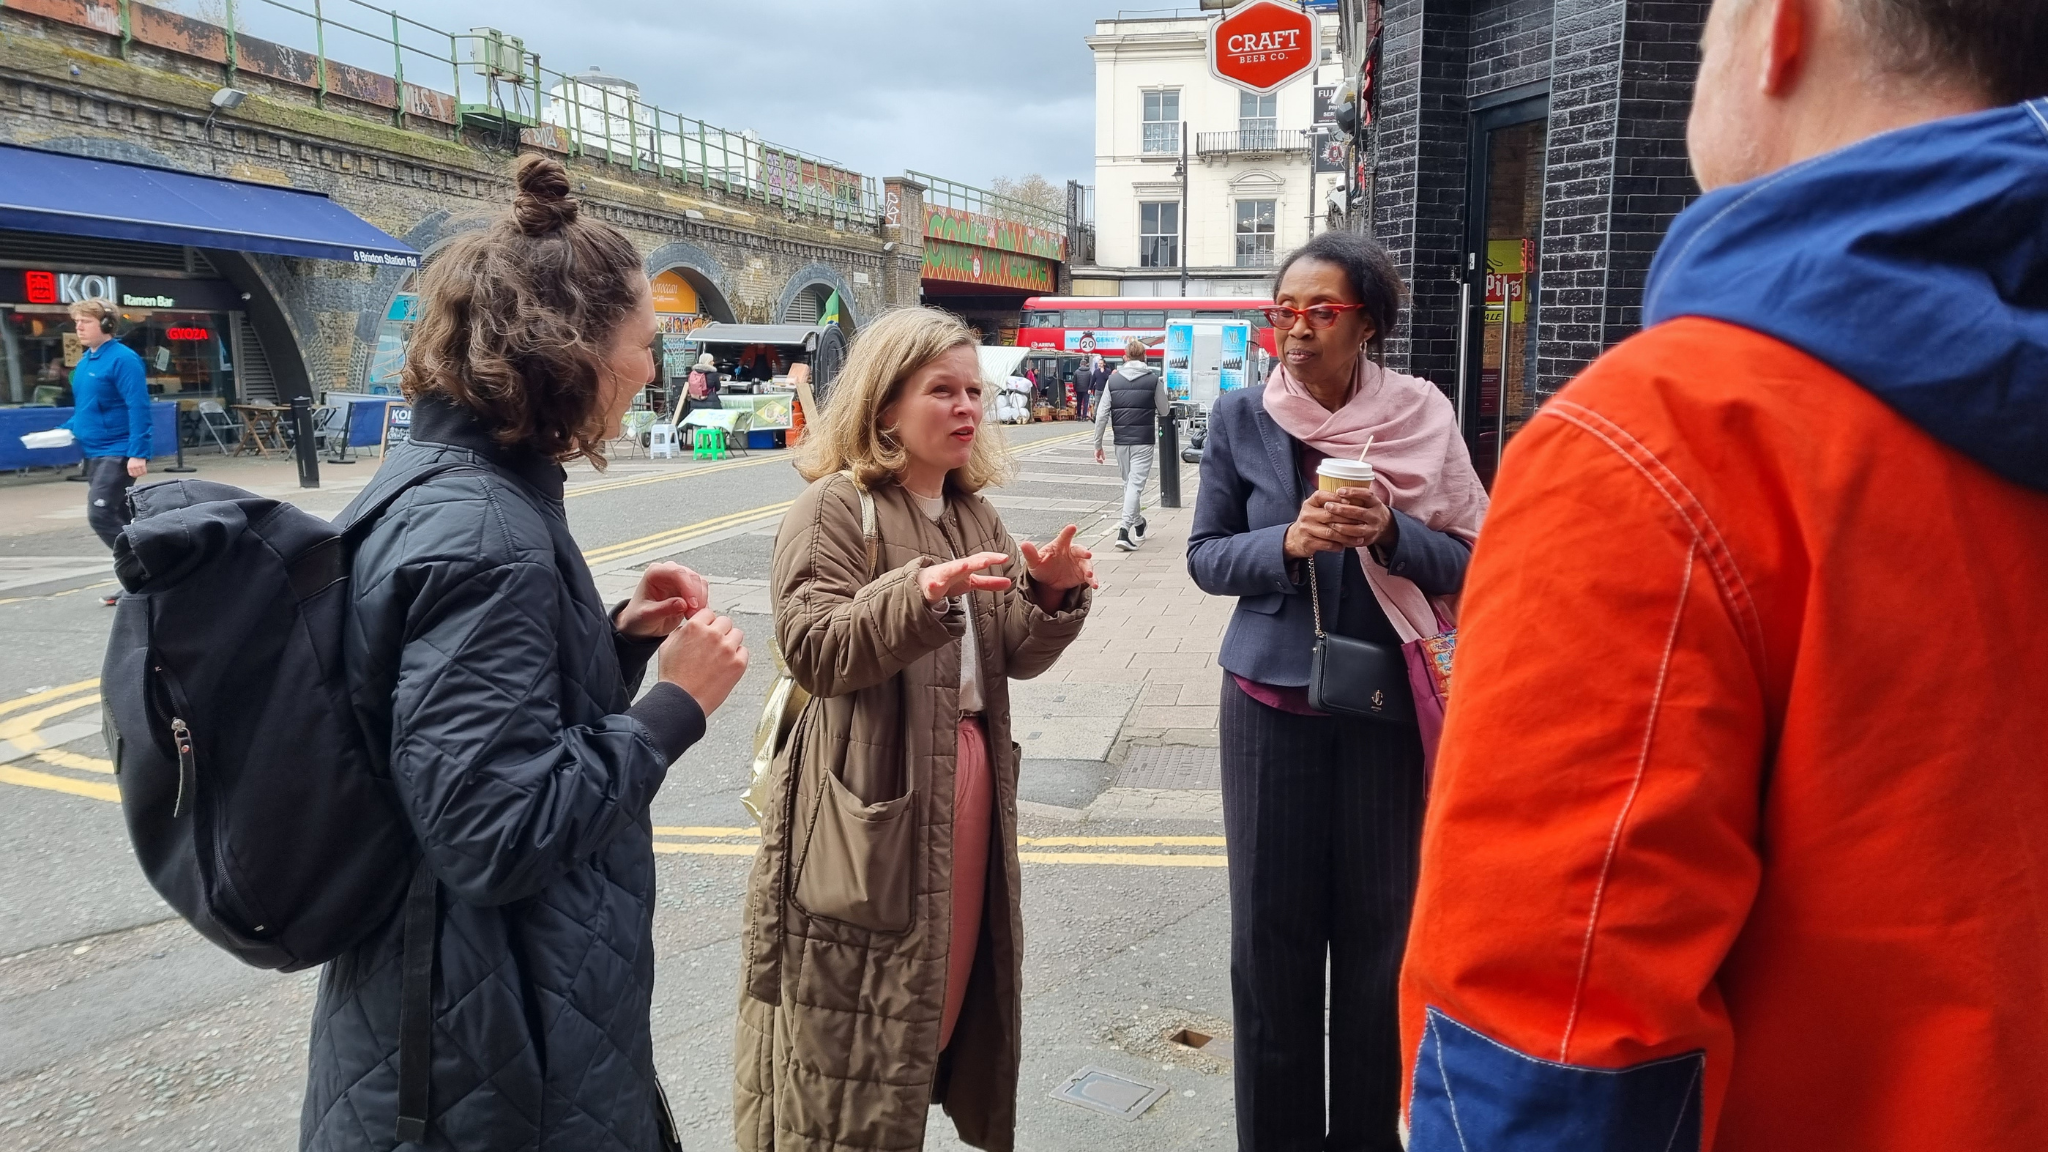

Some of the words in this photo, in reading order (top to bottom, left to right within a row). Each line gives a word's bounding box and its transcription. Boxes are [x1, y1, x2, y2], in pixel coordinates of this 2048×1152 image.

[1227, 29, 1300, 52] CRAFT
[1239, 54, 1266, 64] BEER
[1270, 52, 1289, 61] CO.
[353, 250, 360, 261] 8
[360, 251, 384, 264] Brixton
[383, 253, 407, 266] Station
[407, 256, 417, 267] Rd
[59, 273, 117, 304] KOI
[652, 281, 678, 294] oroccan
[123, 294, 157, 307] Ramen
[157, 295, 174, 308] Bar
[168, 327, 208, 340] GYOZA
[1082, 340, 1094, 349] 20
[391, 409, 412, 420] KOI
